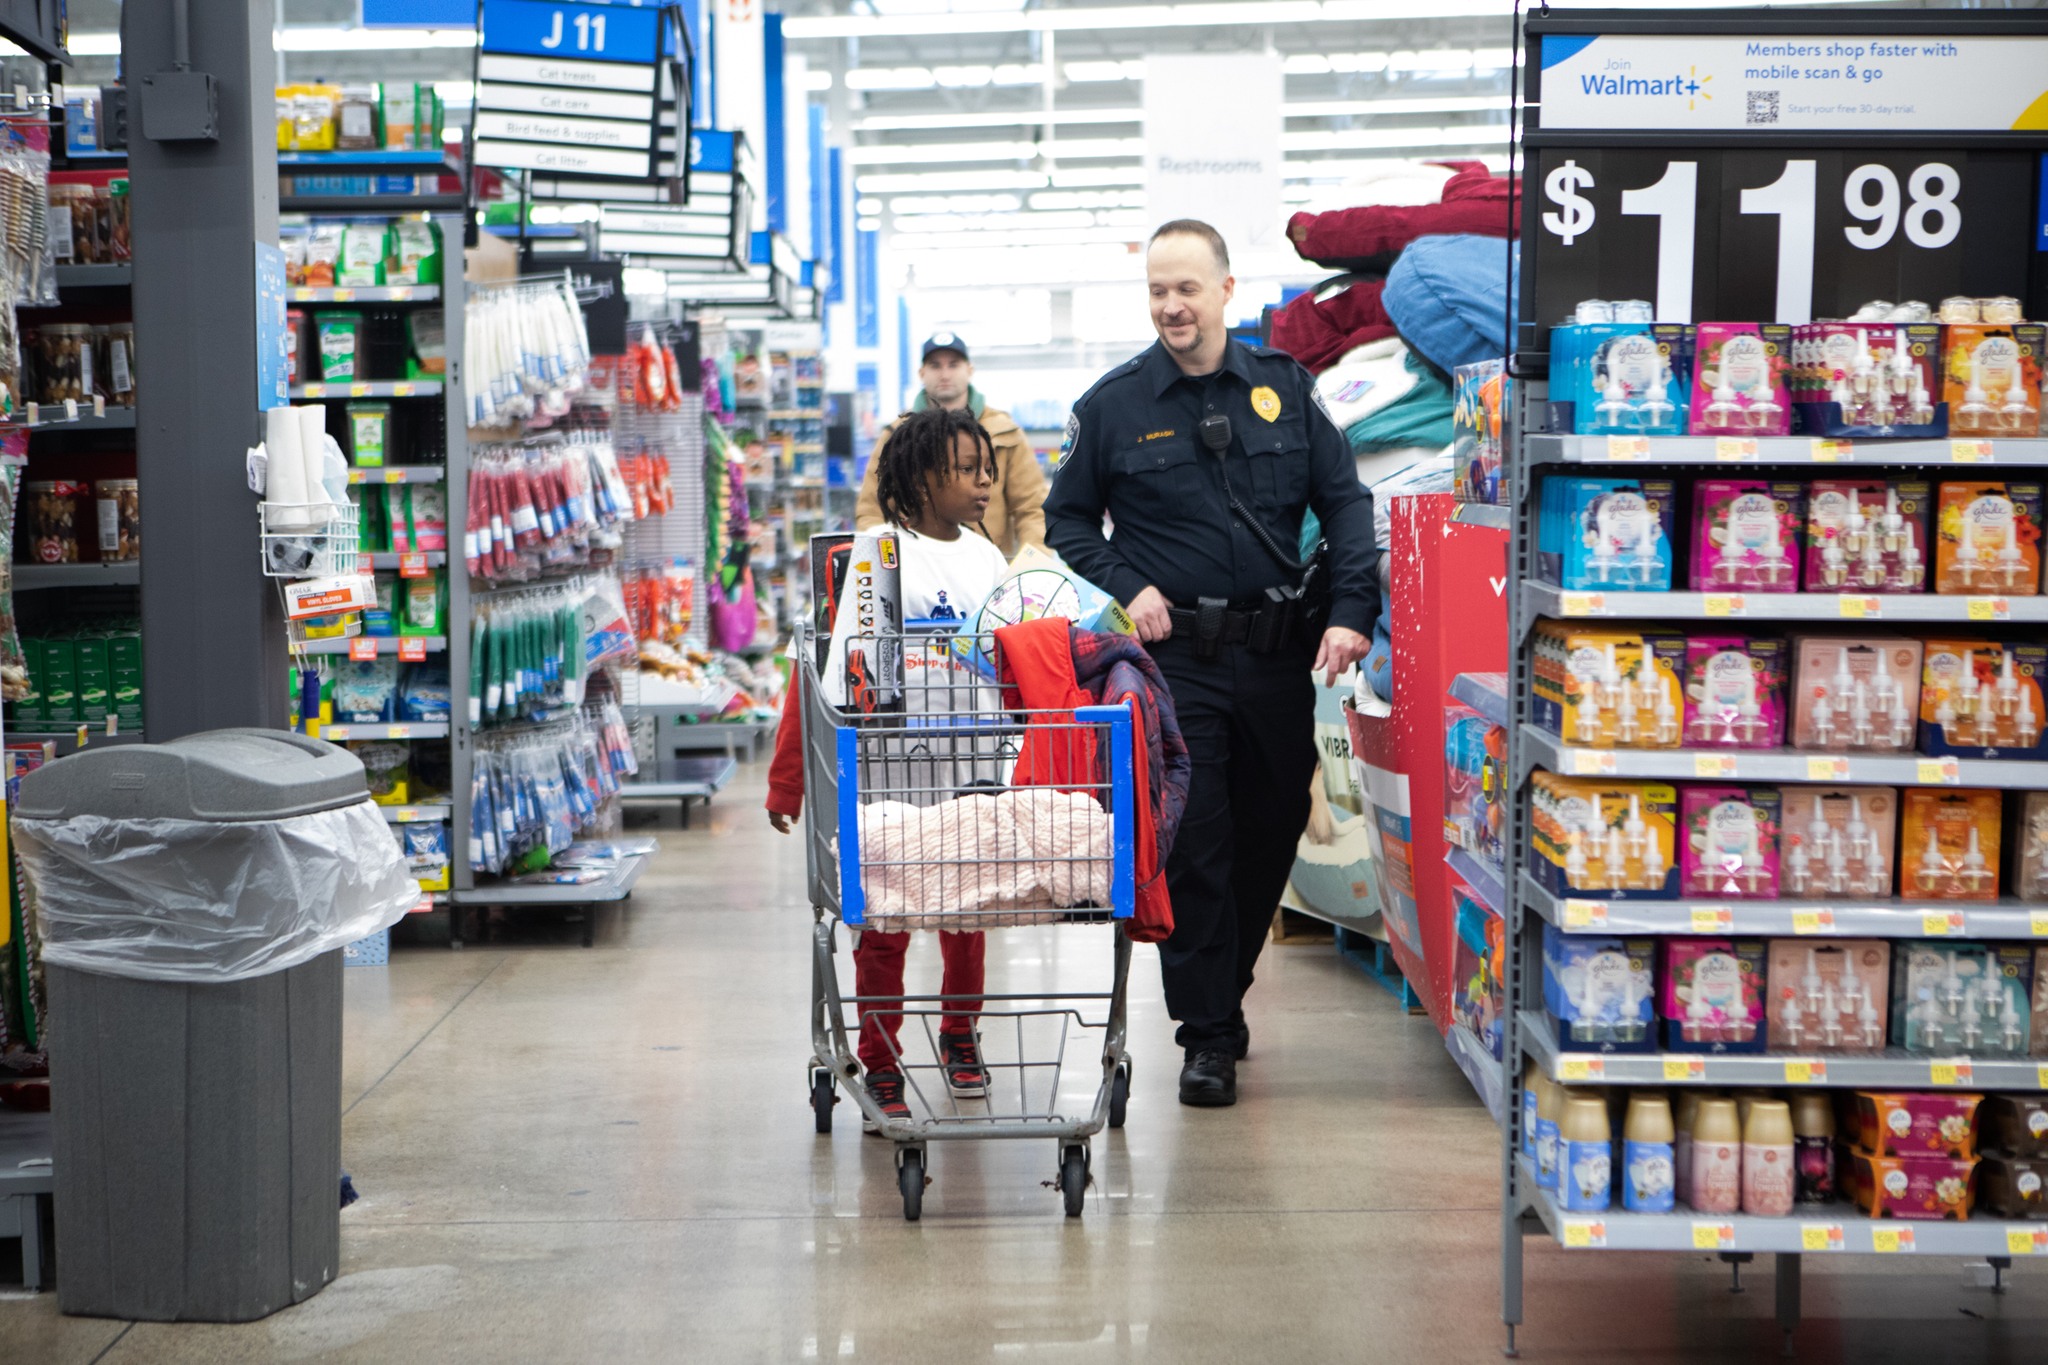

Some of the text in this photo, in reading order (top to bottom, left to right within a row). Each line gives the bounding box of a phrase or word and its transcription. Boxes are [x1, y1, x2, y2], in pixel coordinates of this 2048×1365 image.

[541, 11, 606, 51] J 11
[1745, 42, 1958, 60] Members shop faster with
[1603, 59, 1632, 71] Join
[1745, 64, 1883, 83] mobile scan & go
[538, 67, 596, 83] Cat treats
[540, 96, 590, 110] Cat care
[1788, 103, 1811, 114] Start
[1814, 105, 1835, 116] your
[1837, 103, 1857, 114] free
[1860, 104, 1893, 116] 30-day
[506, 122, 621, 143] Bird feed & supplies
[536, 152, 588, 167] Cat litter
[1158, 154, 1262, 174] Restrooms
[1111, 606, 1132, 631] SHAQ
[905, 653, 938, 670] Shop
